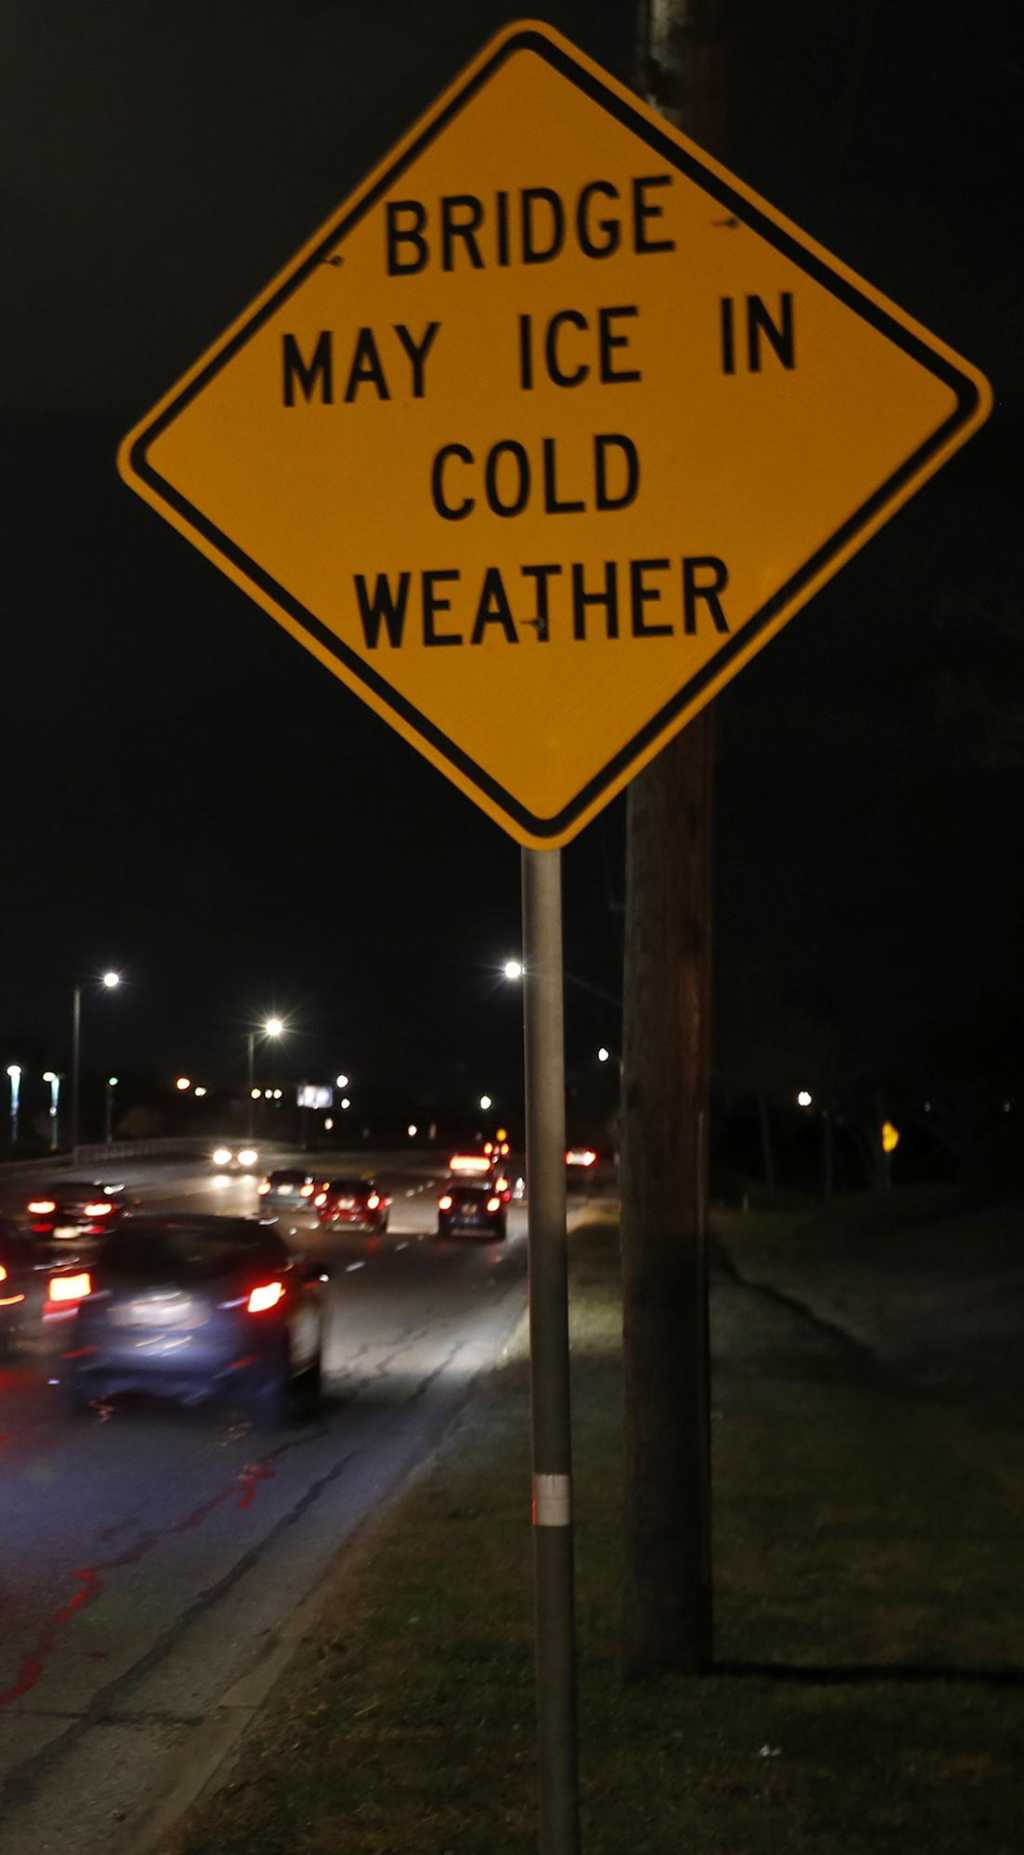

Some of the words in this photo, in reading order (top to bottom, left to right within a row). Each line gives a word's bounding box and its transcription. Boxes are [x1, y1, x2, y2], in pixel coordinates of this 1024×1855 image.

[384, 173, 677, 277] BRIDGE
[281, 320, 442, 408] MAY
[517, 304, 642, 391] ICE
[719, 290, 797, 375] IN
[430, 432, 641, 522] COLD
[353, 554, 730, 650] WEATHER
